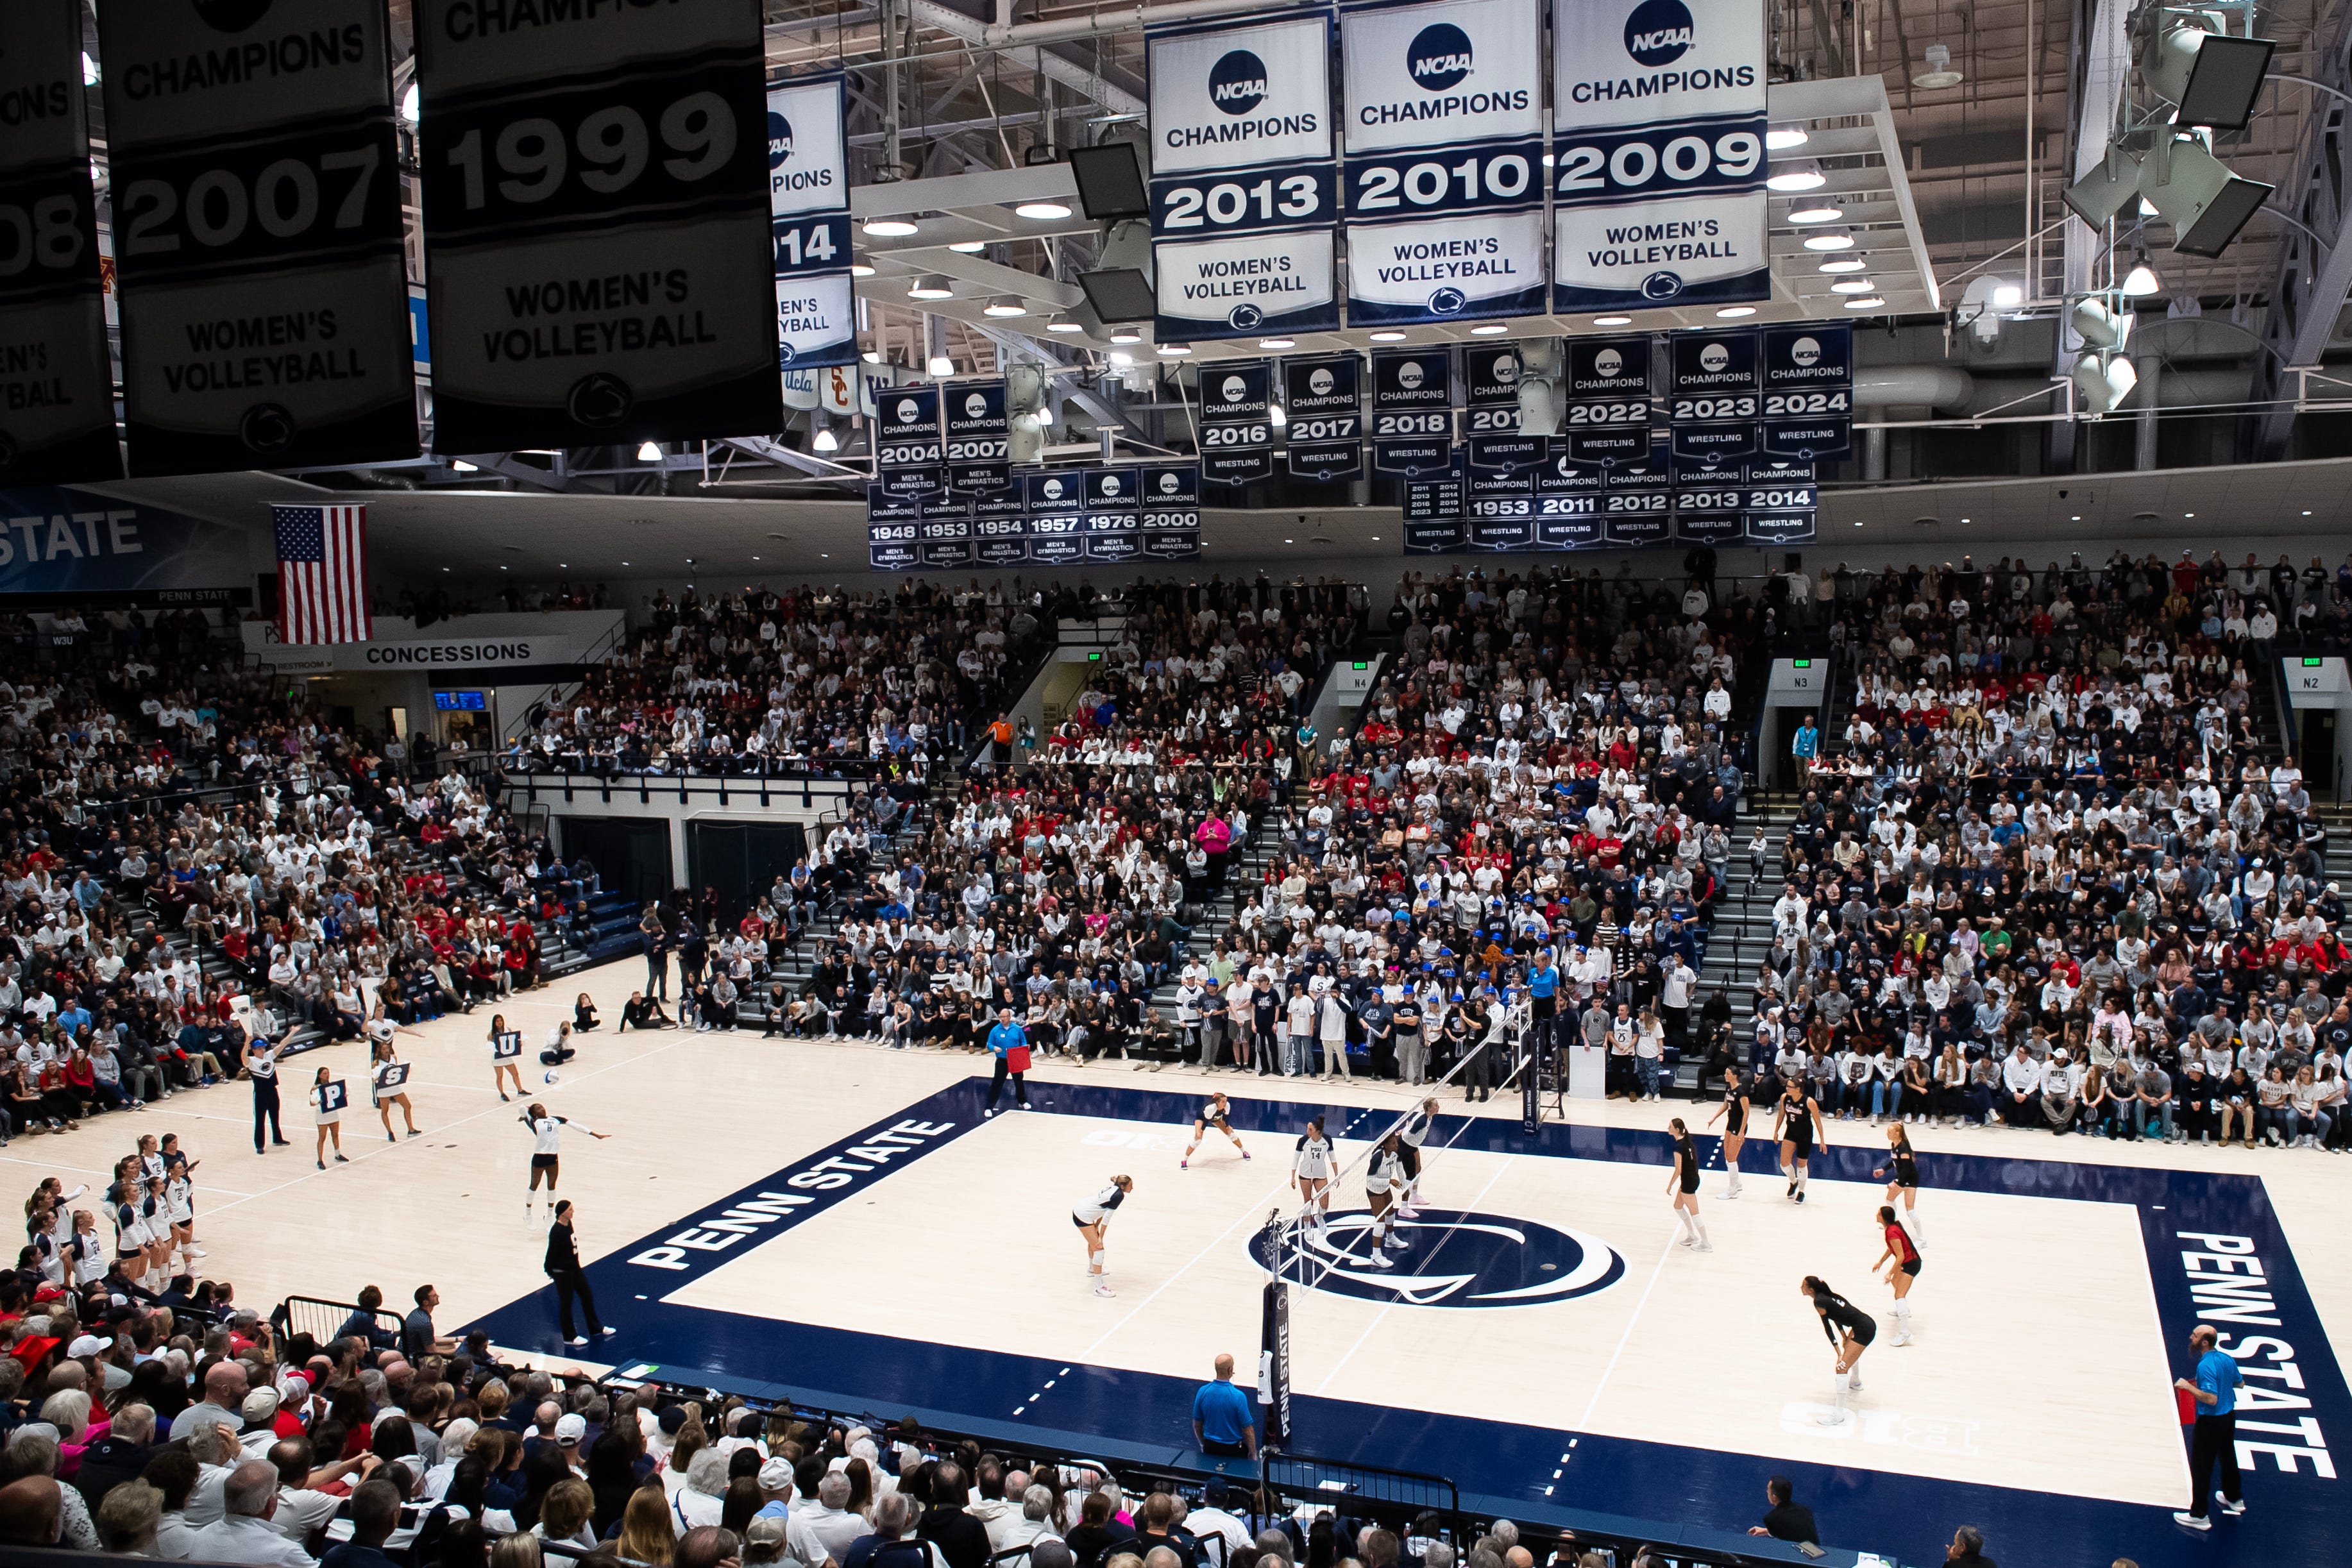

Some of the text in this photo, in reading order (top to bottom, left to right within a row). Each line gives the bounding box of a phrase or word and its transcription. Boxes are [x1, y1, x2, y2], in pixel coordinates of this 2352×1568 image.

[1632, 26, 1691, 52] NCAA
[123, 24, 363, 101] CHAMPIONS
[1414, 53, 1471, 77] NCAA
[1216, 79, 1267, 101] NCAA
[1571, 65, 1755, 103] CHAMPIONS
[1360, 90, 1529, 126] CHAMPIONS
[1166, 113, 1317, 148] CHAMPIONS
[447, 90, 738, 210] 1999
[1559, 132, 1761, 192] 2009
[1357, 155, 1530, 210] 2010
[123, 142, 380, 257] 2007
[1163, 175, 1319, 228] 2013
[1605, 219, 1719, 245] WOMEN'S
[1393, 237, 1498, 261] WOMEN'S
[1587, 240, 1738, 268] VOLLEYBALL
[1198, 256, 1291, 278] WOMEN'S
[1378, 258, 1516, 284] VOLLEYBALL
[506, 269, 688, 319] WOMEN'S
[1183, 276, 1307, 300] VOLLEYBALL
[186, 309, 337, 352] WOMEN'S
[484, 310, 716, 362] VOLLEYBALL
[1704, 356, 1729, 365] NCAA
[1794, 350, 1820, 358] NCAA
[164, 348, 366, 394] VOLLEYBALL
[1598, 362, 1621, 370] NCAA
[1770, 366, 1844, 380] CHAMPIONS
[1313, 380, 1333, 389] NCAA
[1401, 374, 1423, 382] NCAA
[1575, 377, 1643, 390] CHAMPIONS
[1679, 371, 1751, 385] CHAMPIONS
[1292, 394, 1353, 407] CHAMPIONS
[1380, 389, 1444, 401] CHAMPIONS
[968, 405, 986, 413] NCAA
[1205, 401, 1265, 414] CHAMPIONS
[1675, 397, 1756, 419] 2023
[1766, 392, 1848, 414] 2024
[900, 410, 918, 418] NCAA
[1569, 403, 1647, 424] 2022
[883, 423, 936, 435] CHAMPIONS
[951, 417, 1005, 429] CHAMPIONS
[1292, 419, 1355, 439] 2017
[1379, 414, 1446, 434] 2018
[1205, 425, 1267, 445] 2016
[1688, 433, 1742, 443] WRESTLING
[1779, 429, 1834, 440] WRESTLING
[949, 441, 1008, 459] 2007
[1483, 443, 1534, 453] WRESTLING
[1582, 439, 1635, 448] WRESTLING
[881, 444, 940, 463] 2004
[1301, 452, 1348, 462] WRESTLING
[1388, 448, 1437, 458] WRESTLING
[1215, 458, 1260, 468] WRESTLING
[901, 473, 924, 482] MEN'S
[958, 476, 1004, 485] GYMNASTICS
[1542, 476, 1598, 486] CHAMPIONS
[1609, 475, 1666, 484] CHAMPIONS
[1680, 471, 1739, 481] CHAMPIONS
[1752, 469, 1811, 478] CHAMPIONS
[890, 480, 935, 489] GYMNASTICS
[1474, 480, 1529, 489] CHAMPIONS
[1031, 498, 1078, 509] CHAMPIONS
[1088, 496, 1135, 505] CHAMPIONS
[1146, 493, 1195, 503] CHAMPIONS
[1608, 495, 1666, 510] 2012
[1679, 493, 1739, 509] 2013
[1750, 491, 1811, 507] 2014
[872, 508, 915, 517] CHAMPIONS
[924, 505, 966, 514] CHAMPIONS
[977, 501, 1022, 511] CHAMPIONS
[1473, 501, 1530, 514] 1953
[1543, 498, 1595, 514] 2011
[977, 519, 1022, 535] 1954
[1031, 518, 1078, 533] 1957
[1088, 514, 1136, 529] 1976
[1143, 512, 1197, 528] 2000
[872, 526, 915, 540] 1948
[923, 523, 967, 537] 1953
[158, 590, 231, 602] PENN STATE
[366, 643, 531, 664] CONCESSIONS
[276, 661, 323, 670] RESTROOM
[1355, 679, 1366, 688] N4
[1794, 677, 1807, 687] N3
[2303, 678, 2319, 688] N2
[498, 1034, 516, 1055] U
[384, 1066, 402, 1085] S
[325, 1084, 341, 1108] P
[627, 1118, 956, 1270] PENN STATE
[2176, 1231, 2337, 1479] PENN STATE
[1279, 1324, 1290, 1438] PENN STATE
